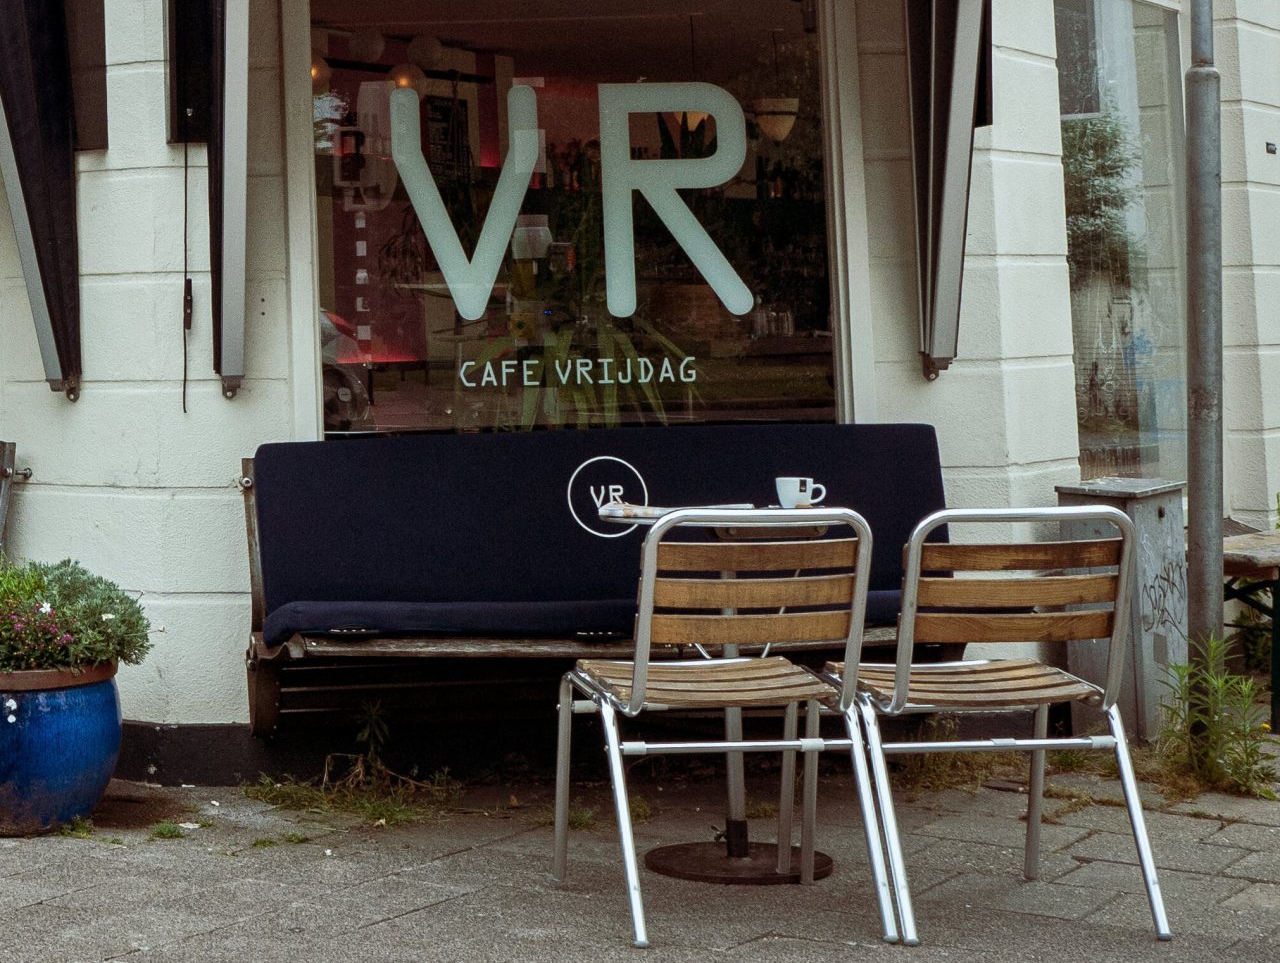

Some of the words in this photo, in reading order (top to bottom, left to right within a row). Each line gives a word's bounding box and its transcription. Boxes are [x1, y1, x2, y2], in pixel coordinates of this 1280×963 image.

[389, 81, 755, 321] VR
[459, 360, 540, 386] CAFE
[555, 356, 696, 385] VRIJDAG
[590, 485, 624, 509] VR
